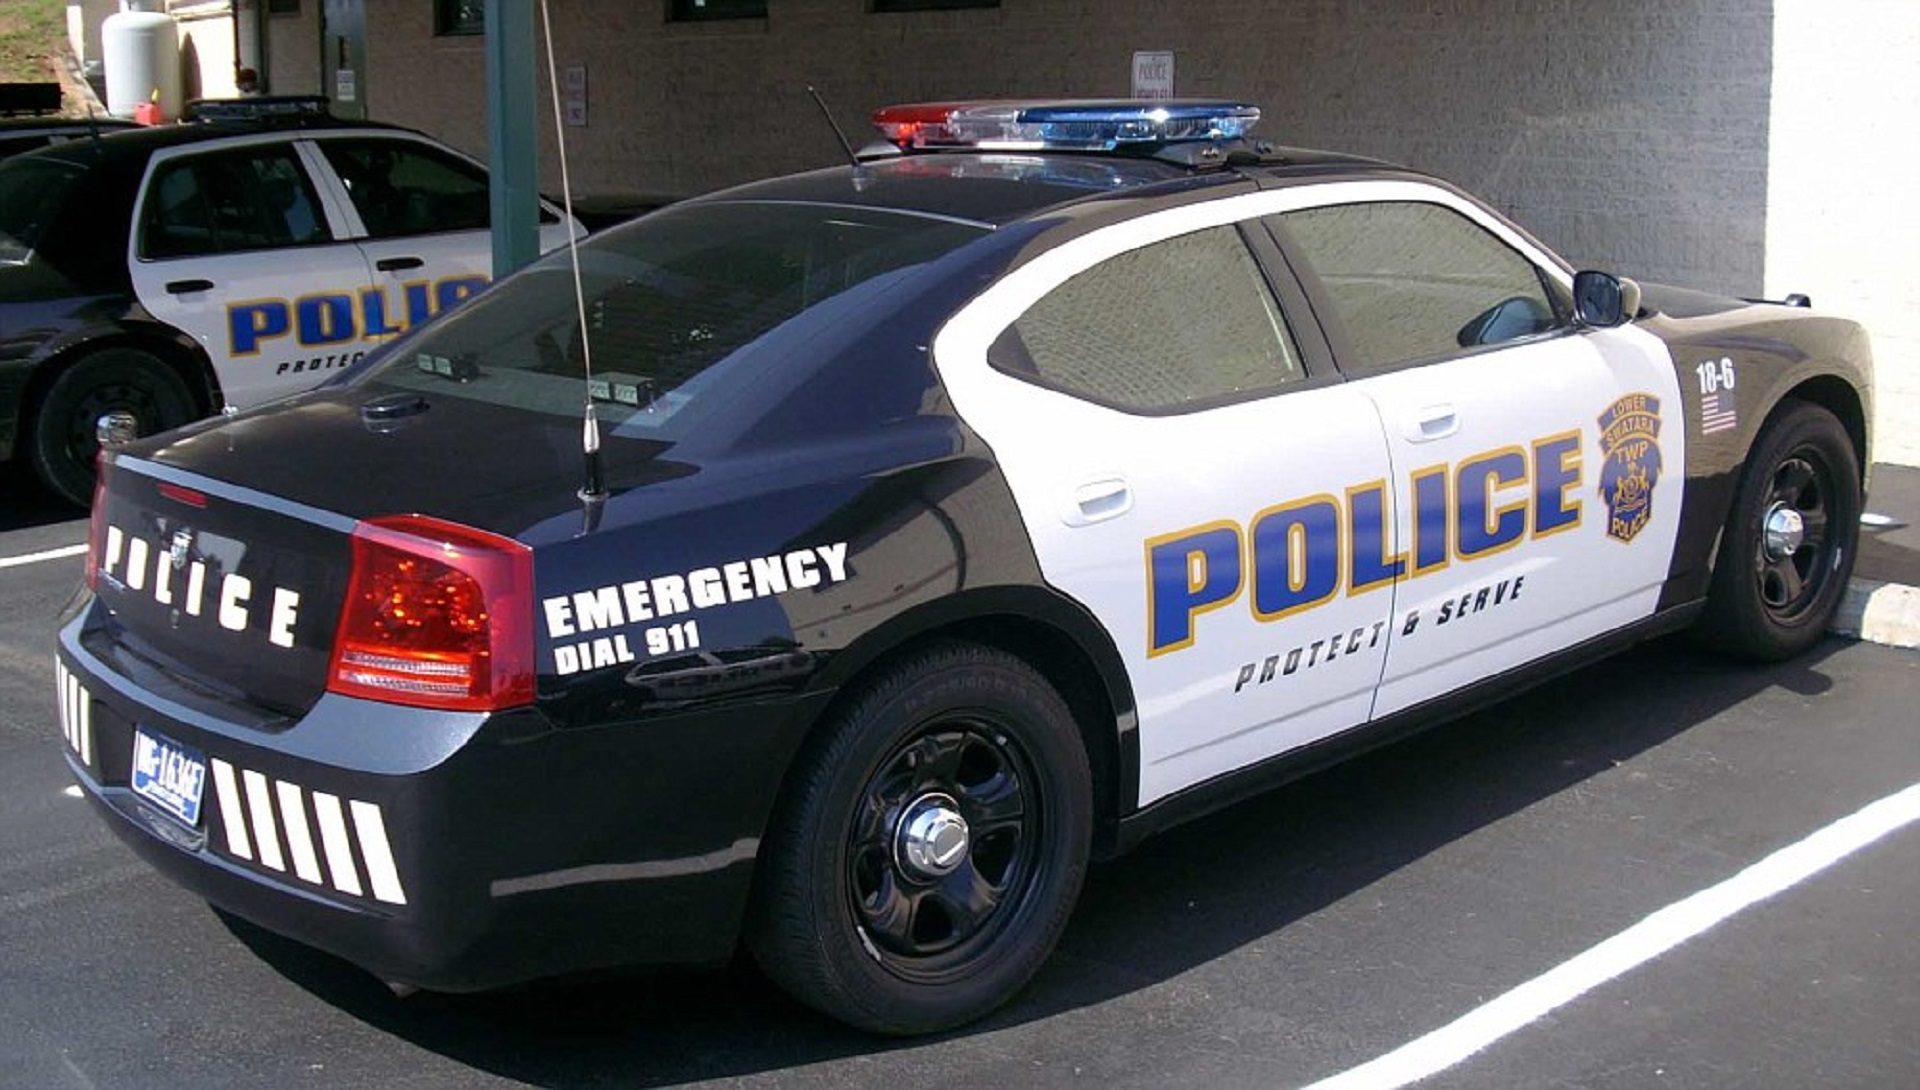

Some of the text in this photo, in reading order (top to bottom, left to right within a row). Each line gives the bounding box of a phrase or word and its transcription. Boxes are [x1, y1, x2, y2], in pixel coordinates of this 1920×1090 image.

[1138, 62, 1168, 80] POLICE
[1696, 357, 1735, 393] 18-6
[1612, 396, 1646, 417] LOWER
[1606, 415, 1655, 448] SWATARA
[1616, 441, 1648, 465] TWP
[1612, 508, 1648, 538] POLICE
[1144, 428, 1582, 659] POLICE
[105, 525, 300, 648] POLICE
[542, 542, 848, 638] EMERGENCY
[554, 620, 700, 676] DIAL 911
[1234, 575, 1526, 693] PROTECT & SERVE
